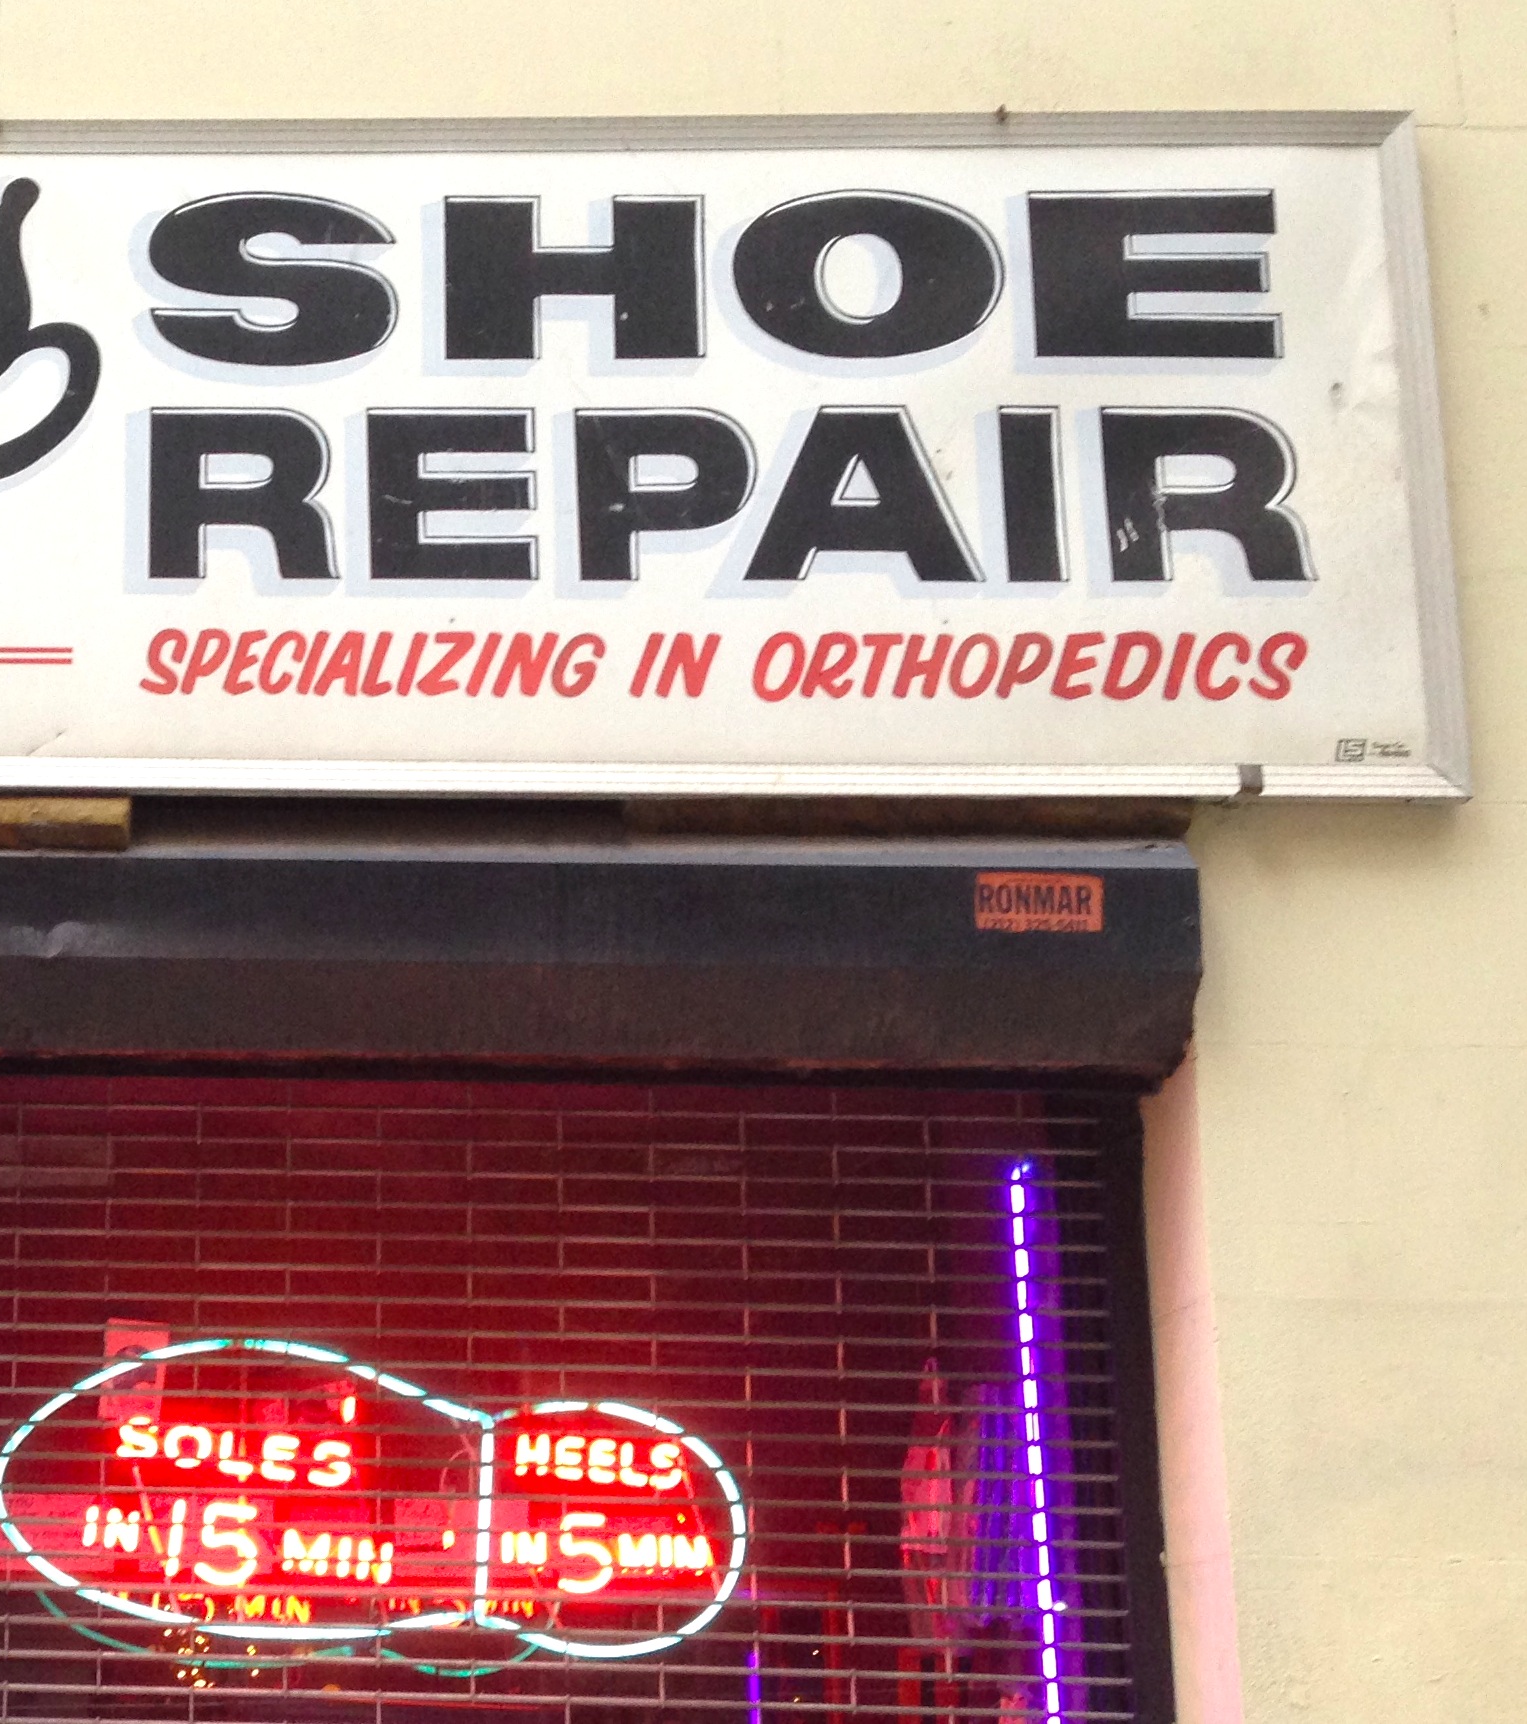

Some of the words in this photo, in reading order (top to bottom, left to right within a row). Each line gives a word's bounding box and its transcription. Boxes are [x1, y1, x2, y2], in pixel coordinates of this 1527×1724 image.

[147, 188, 1283, 367] SHOE
[148, 405, 1319, 582] REPAIR
[139, 627, 606, 698] SPECIALIZING
[628, 631, 722, 698] IN
[751, 630, 1309, 702] ORTHOPEDICS
[977, 883, 1093, 915] RONMAR
[115, 1414, 353, 1488] SOLES
[514, 1433, 683, 1490] HEELS
[82, 1504, 140, 1553] IN
[164, 1498, 258, 1586] 15
[281, 1528, 394, 1584] MIN
[500, 1530, 548, 1566] IN
[557, 1511, 614, 1594] 5
[616, 1532, 714, 1574] MIN
